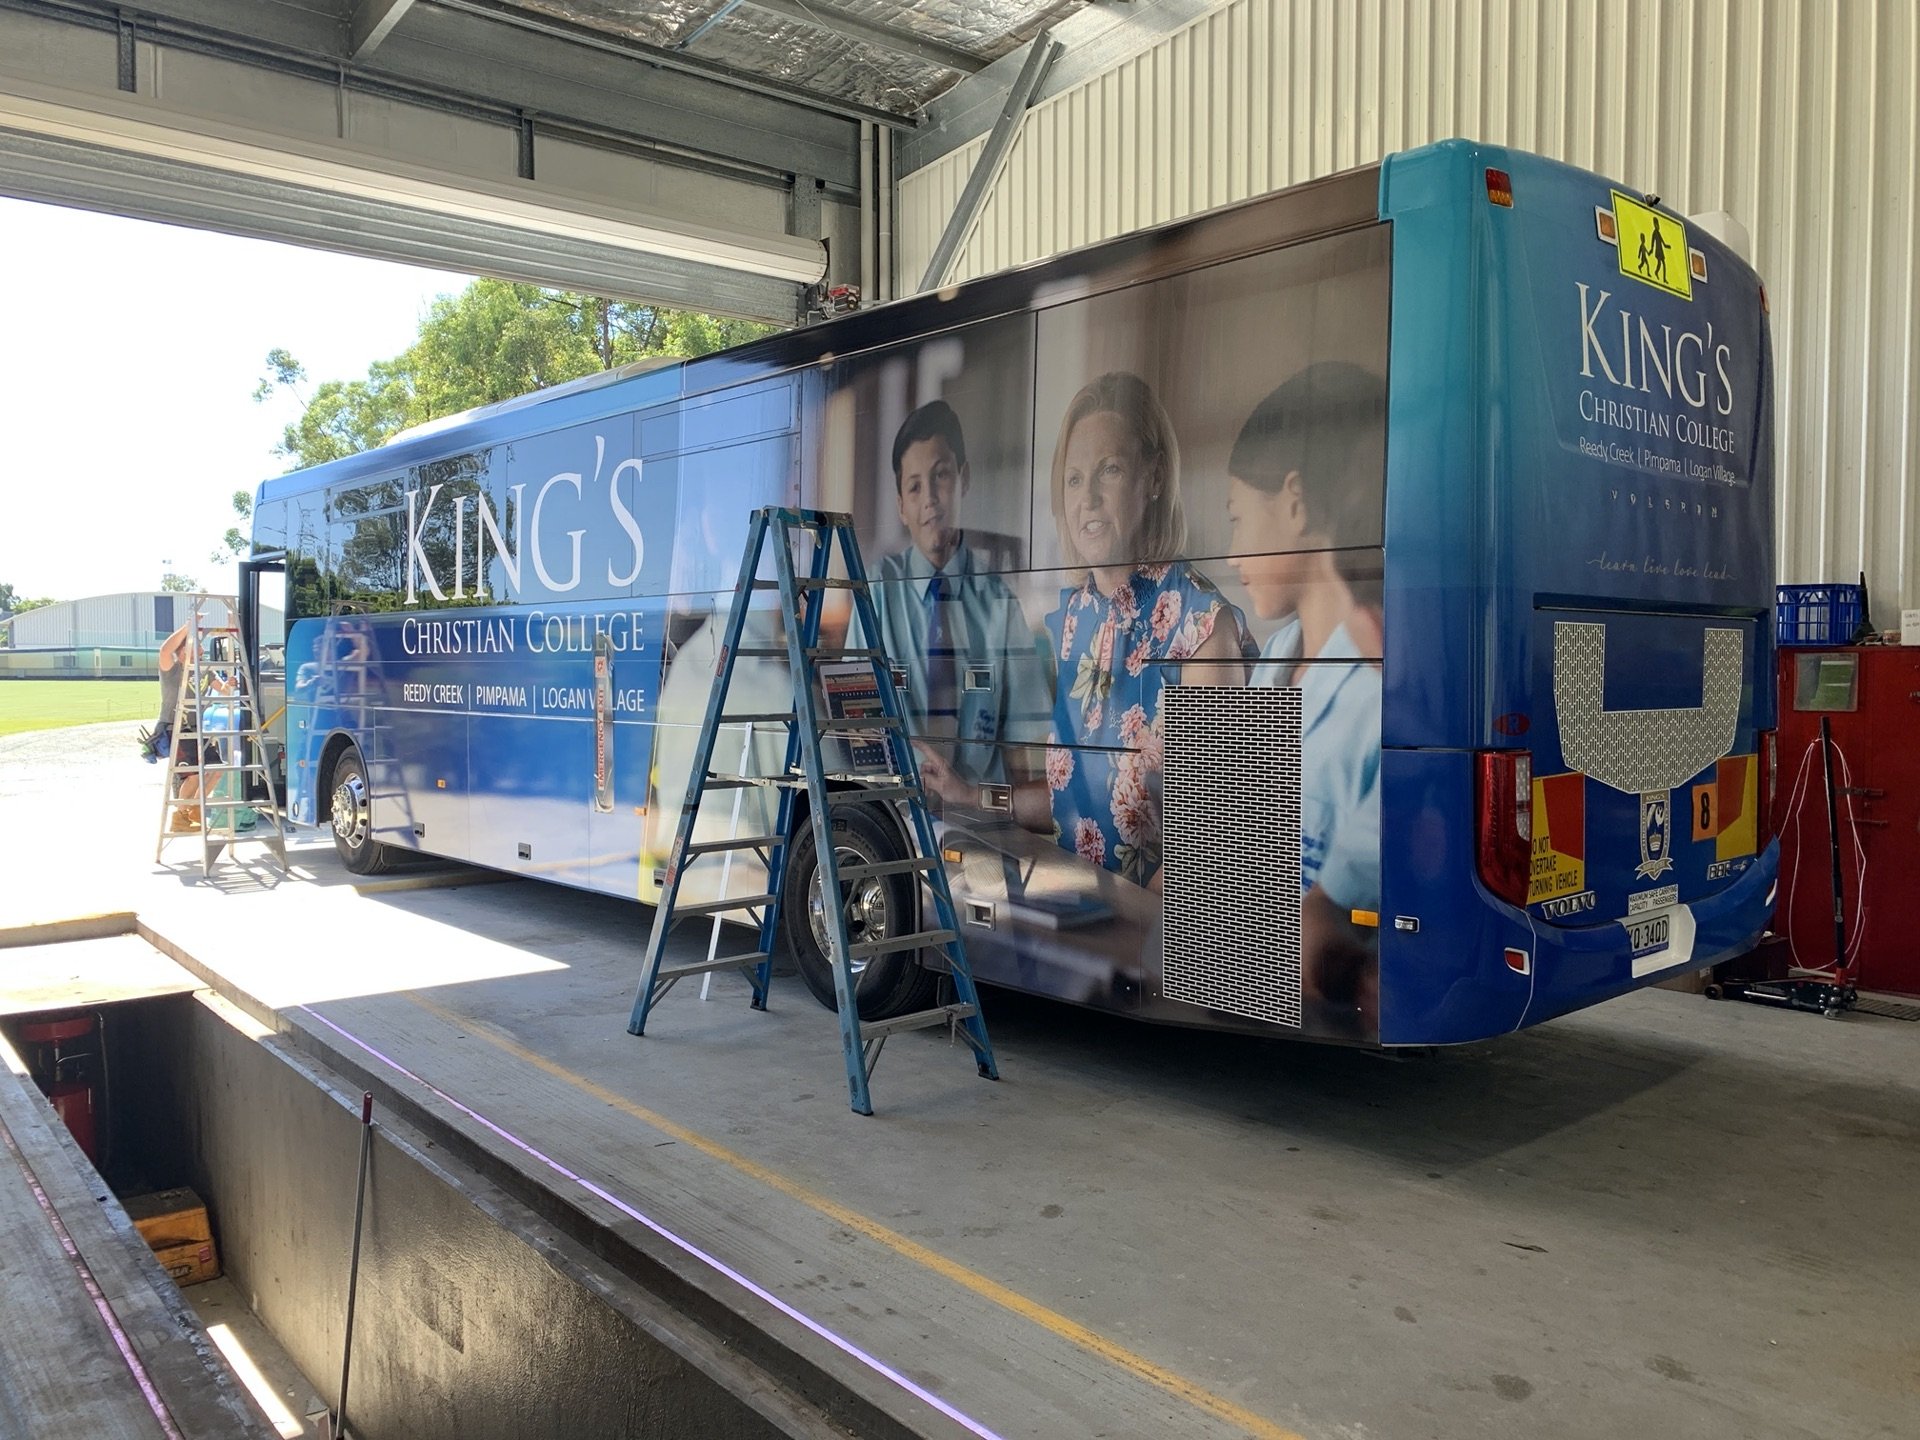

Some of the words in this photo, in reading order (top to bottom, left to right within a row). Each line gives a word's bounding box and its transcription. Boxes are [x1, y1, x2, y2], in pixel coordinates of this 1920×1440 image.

[1575, 281, 1733, 416] KING'S
[1580, 390, 1670, 438] CHRISTIAN
[1676, 414, 1735, 454] COLLEGE
[1580, 436, 1609, 463] Reedy
[1610, 442, 1634, 464] Creek
[1644, 451, 1681, 473] Pimpama
[1690, 460, 1712, 481] Logan
[1713, 464, 1735, 487] Village
[403, 435, 645, 605] KING'S
[1643, 555, 1669, 575] live
[1674, 558, 1698, 577] love
[1703, 561, 1737, 581] lead
[402, 617, 515, 655] CHRISTIAN
[526, 610, 645, 653] COLLEGE
[403, 683, 432, 704] REEDY
[433, 684, 464, 705] CREEK
[476, 685, 527, 708] PIMPAMA
[542, 687, 586, 710] LOGAN
[1701, 791, 1710, 830] 8
[1538, 836, 1549, 854] NOT
[1554, 869, 1578, 891] VEHICLE
[1542, 891, 1596, 920] VOLVO
